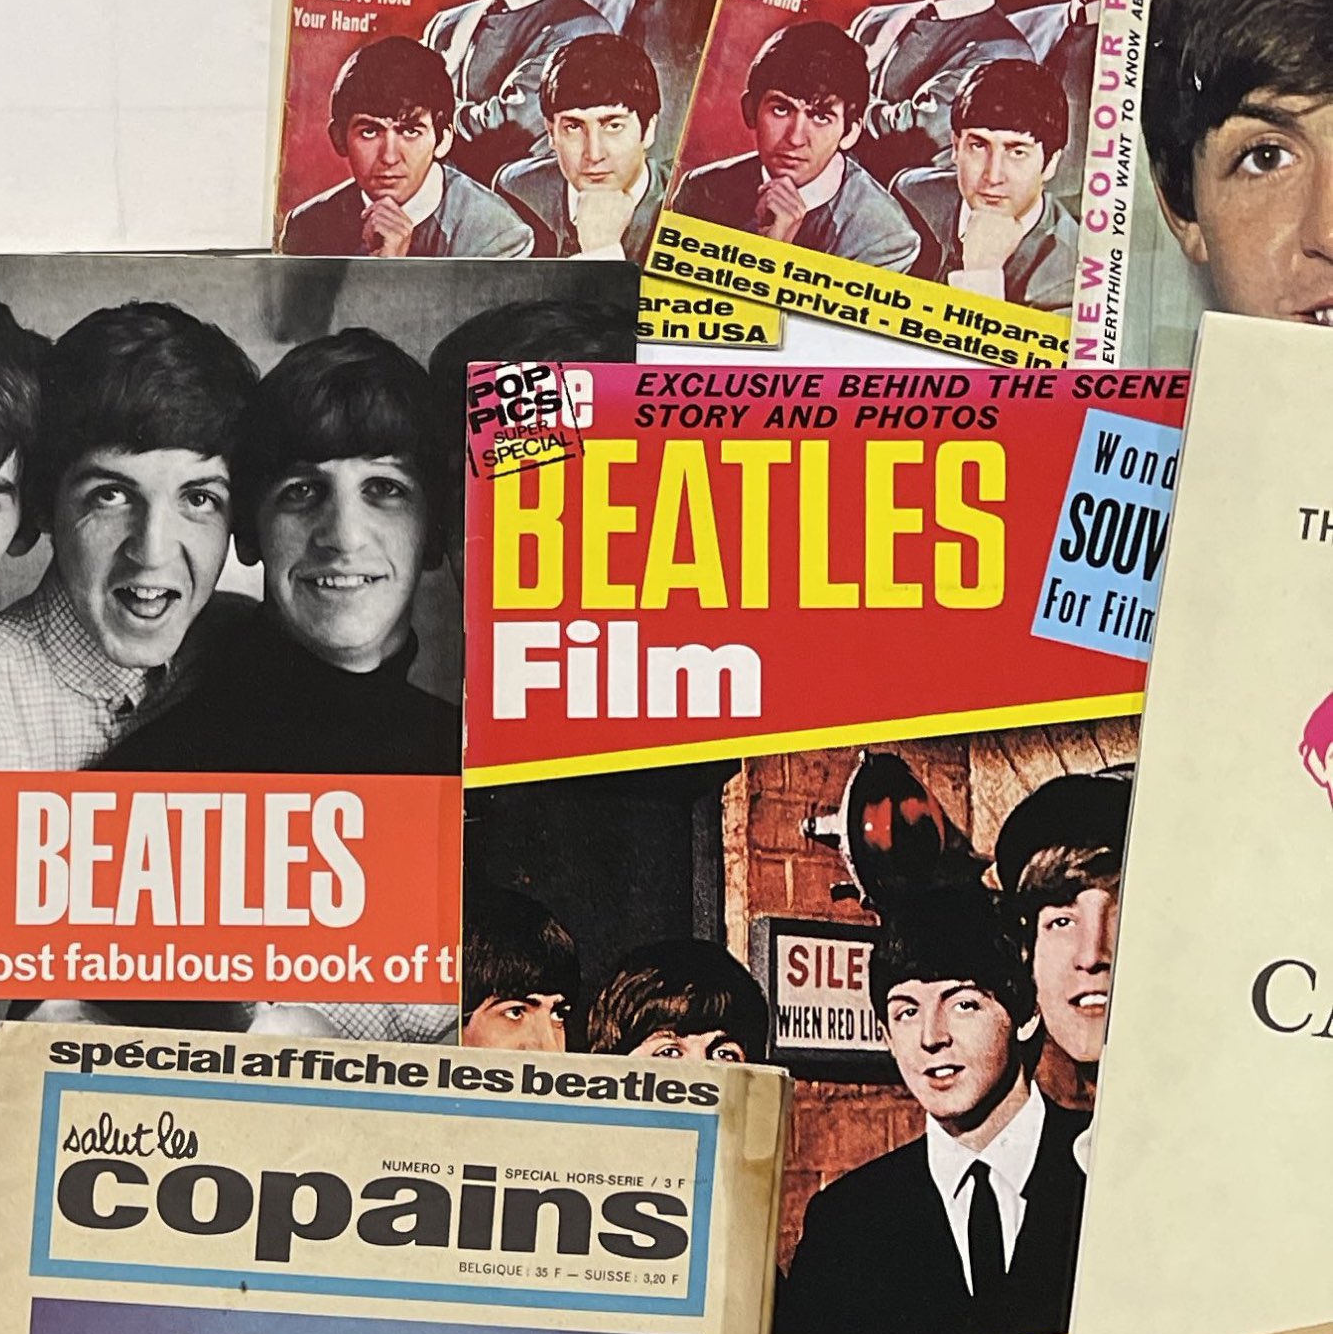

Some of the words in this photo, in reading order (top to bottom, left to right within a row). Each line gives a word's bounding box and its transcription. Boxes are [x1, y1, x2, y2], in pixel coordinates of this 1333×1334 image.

[1123, 30, 1142, 90] KNOW
[1121, 98, 1136, 125] TO
[1116, 132, 1133, 188] WANT
[1112, 192, 1129, 236] YOU
[1102, 247, 1125, 365] EVERYTHING
[635, 372, 823, 399] EXCLUSIVE
[837, 373, 971, 399] BEHIND
[988, 374, 1058, 399] THE
[492, 438, 1007, 611] BEATLES
[491, 620, 763, 721] Film
[15, 790, 366, 929] BEATLES
[64, 941, 253, 984] fabulous
[266, 944, 375, 984] book
[384, 945, 429, 984] of
[49, 1038, 241, 1076] spécial
[242, 1052, 429, 1089] affiche
[437, 1060, 514, 1093] les
[522, 1063, 721, 1107] beatles
[63, 1112, 154, 1157] salut
[157, 1111, 200, 1159] les
[504, 1166, 560, 1185] SPECIAL
[566, 1170, 645, 1189] HORS-SERIE
[56, 1157, 691, 1265] copains
